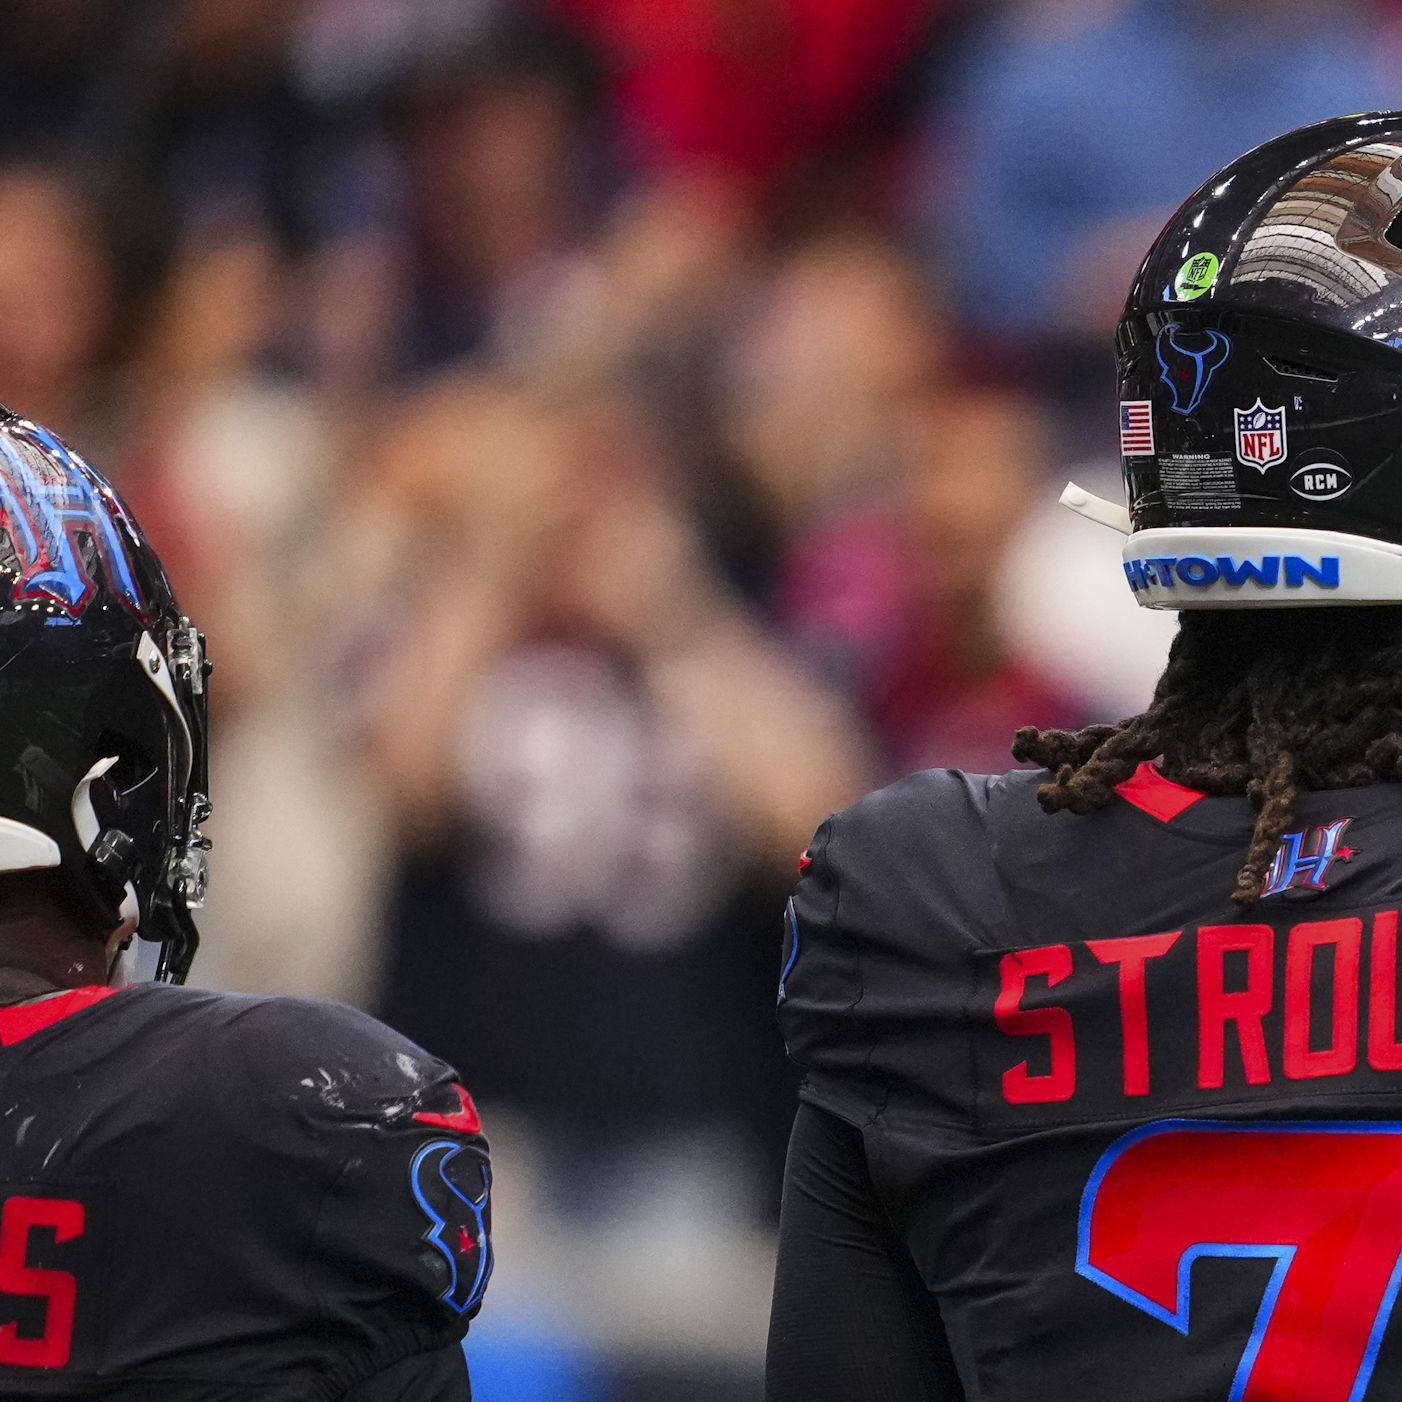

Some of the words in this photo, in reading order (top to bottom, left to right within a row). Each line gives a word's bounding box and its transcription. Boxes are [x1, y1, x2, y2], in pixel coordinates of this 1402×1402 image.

[1241, 432, 1281, 462] NFL
[1172, 453, 1211, 461] WARNING
[1303, 473, 1338, 491] RCM
